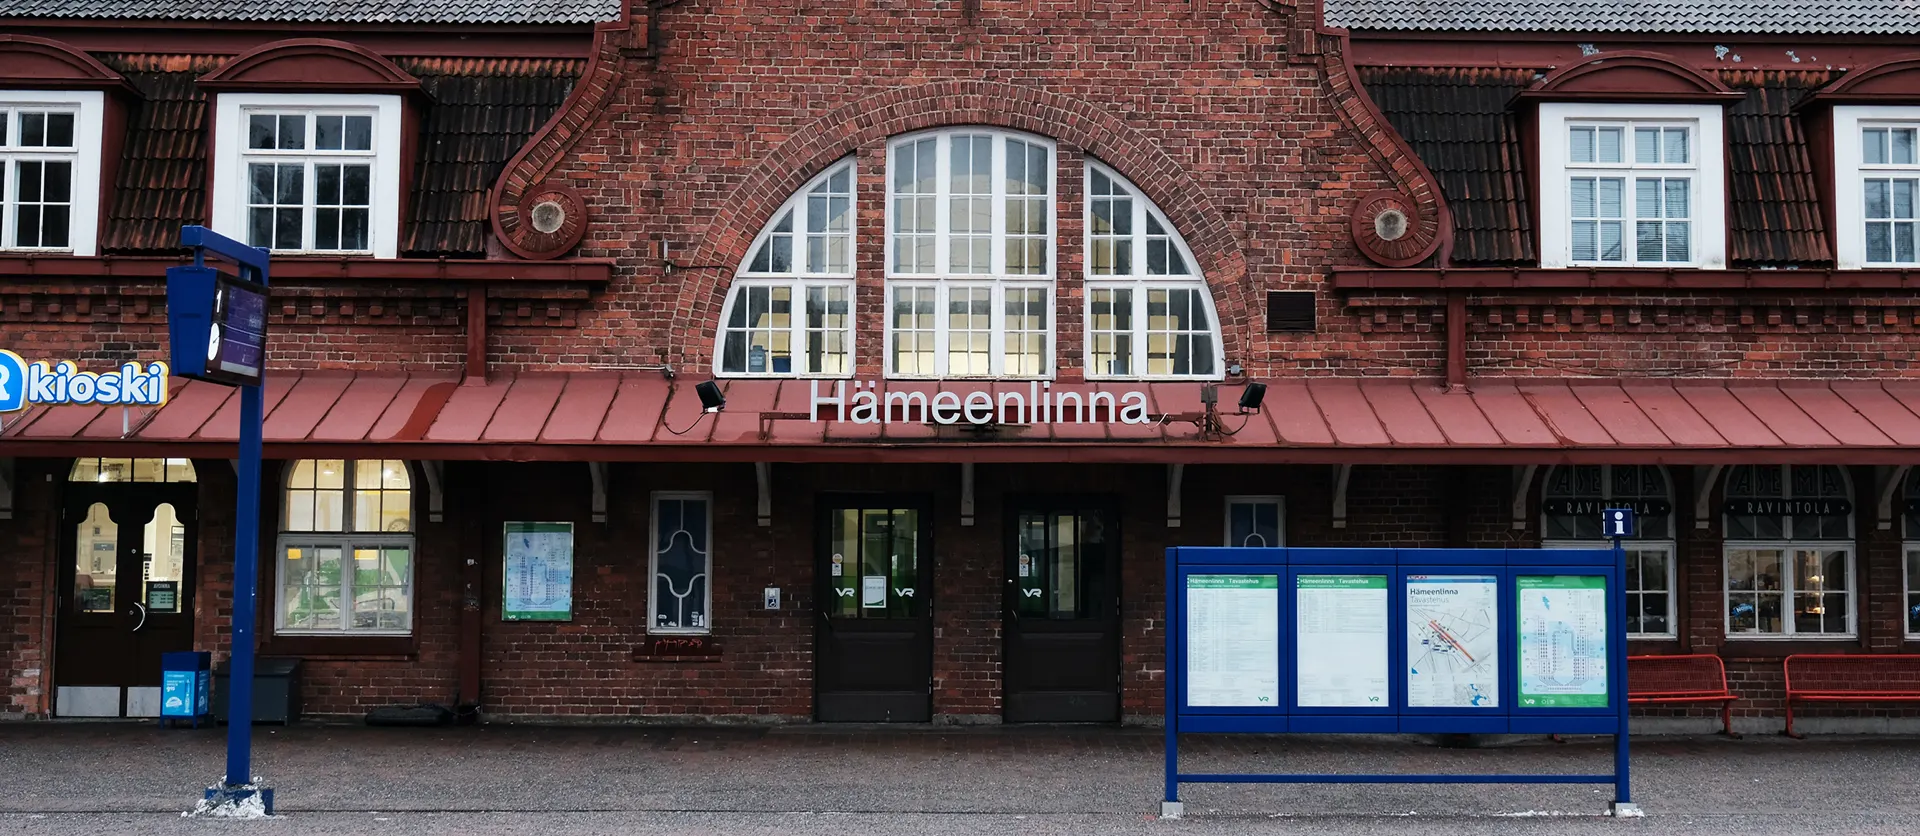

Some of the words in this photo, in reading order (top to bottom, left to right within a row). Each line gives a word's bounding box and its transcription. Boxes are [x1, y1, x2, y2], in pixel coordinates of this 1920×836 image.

[28, 362, 162, 404] kioski
[810, 380, 1149, 424] Hämeenlinna
[1747, 501, 1831, 515] RAVINTOLA
[835, 587, 855, 597] VR
[895, 587, 915, 597] VR
[1022, 588, 1042, 598] VR
[1410, 596, 1450, 604] Tavastehus
